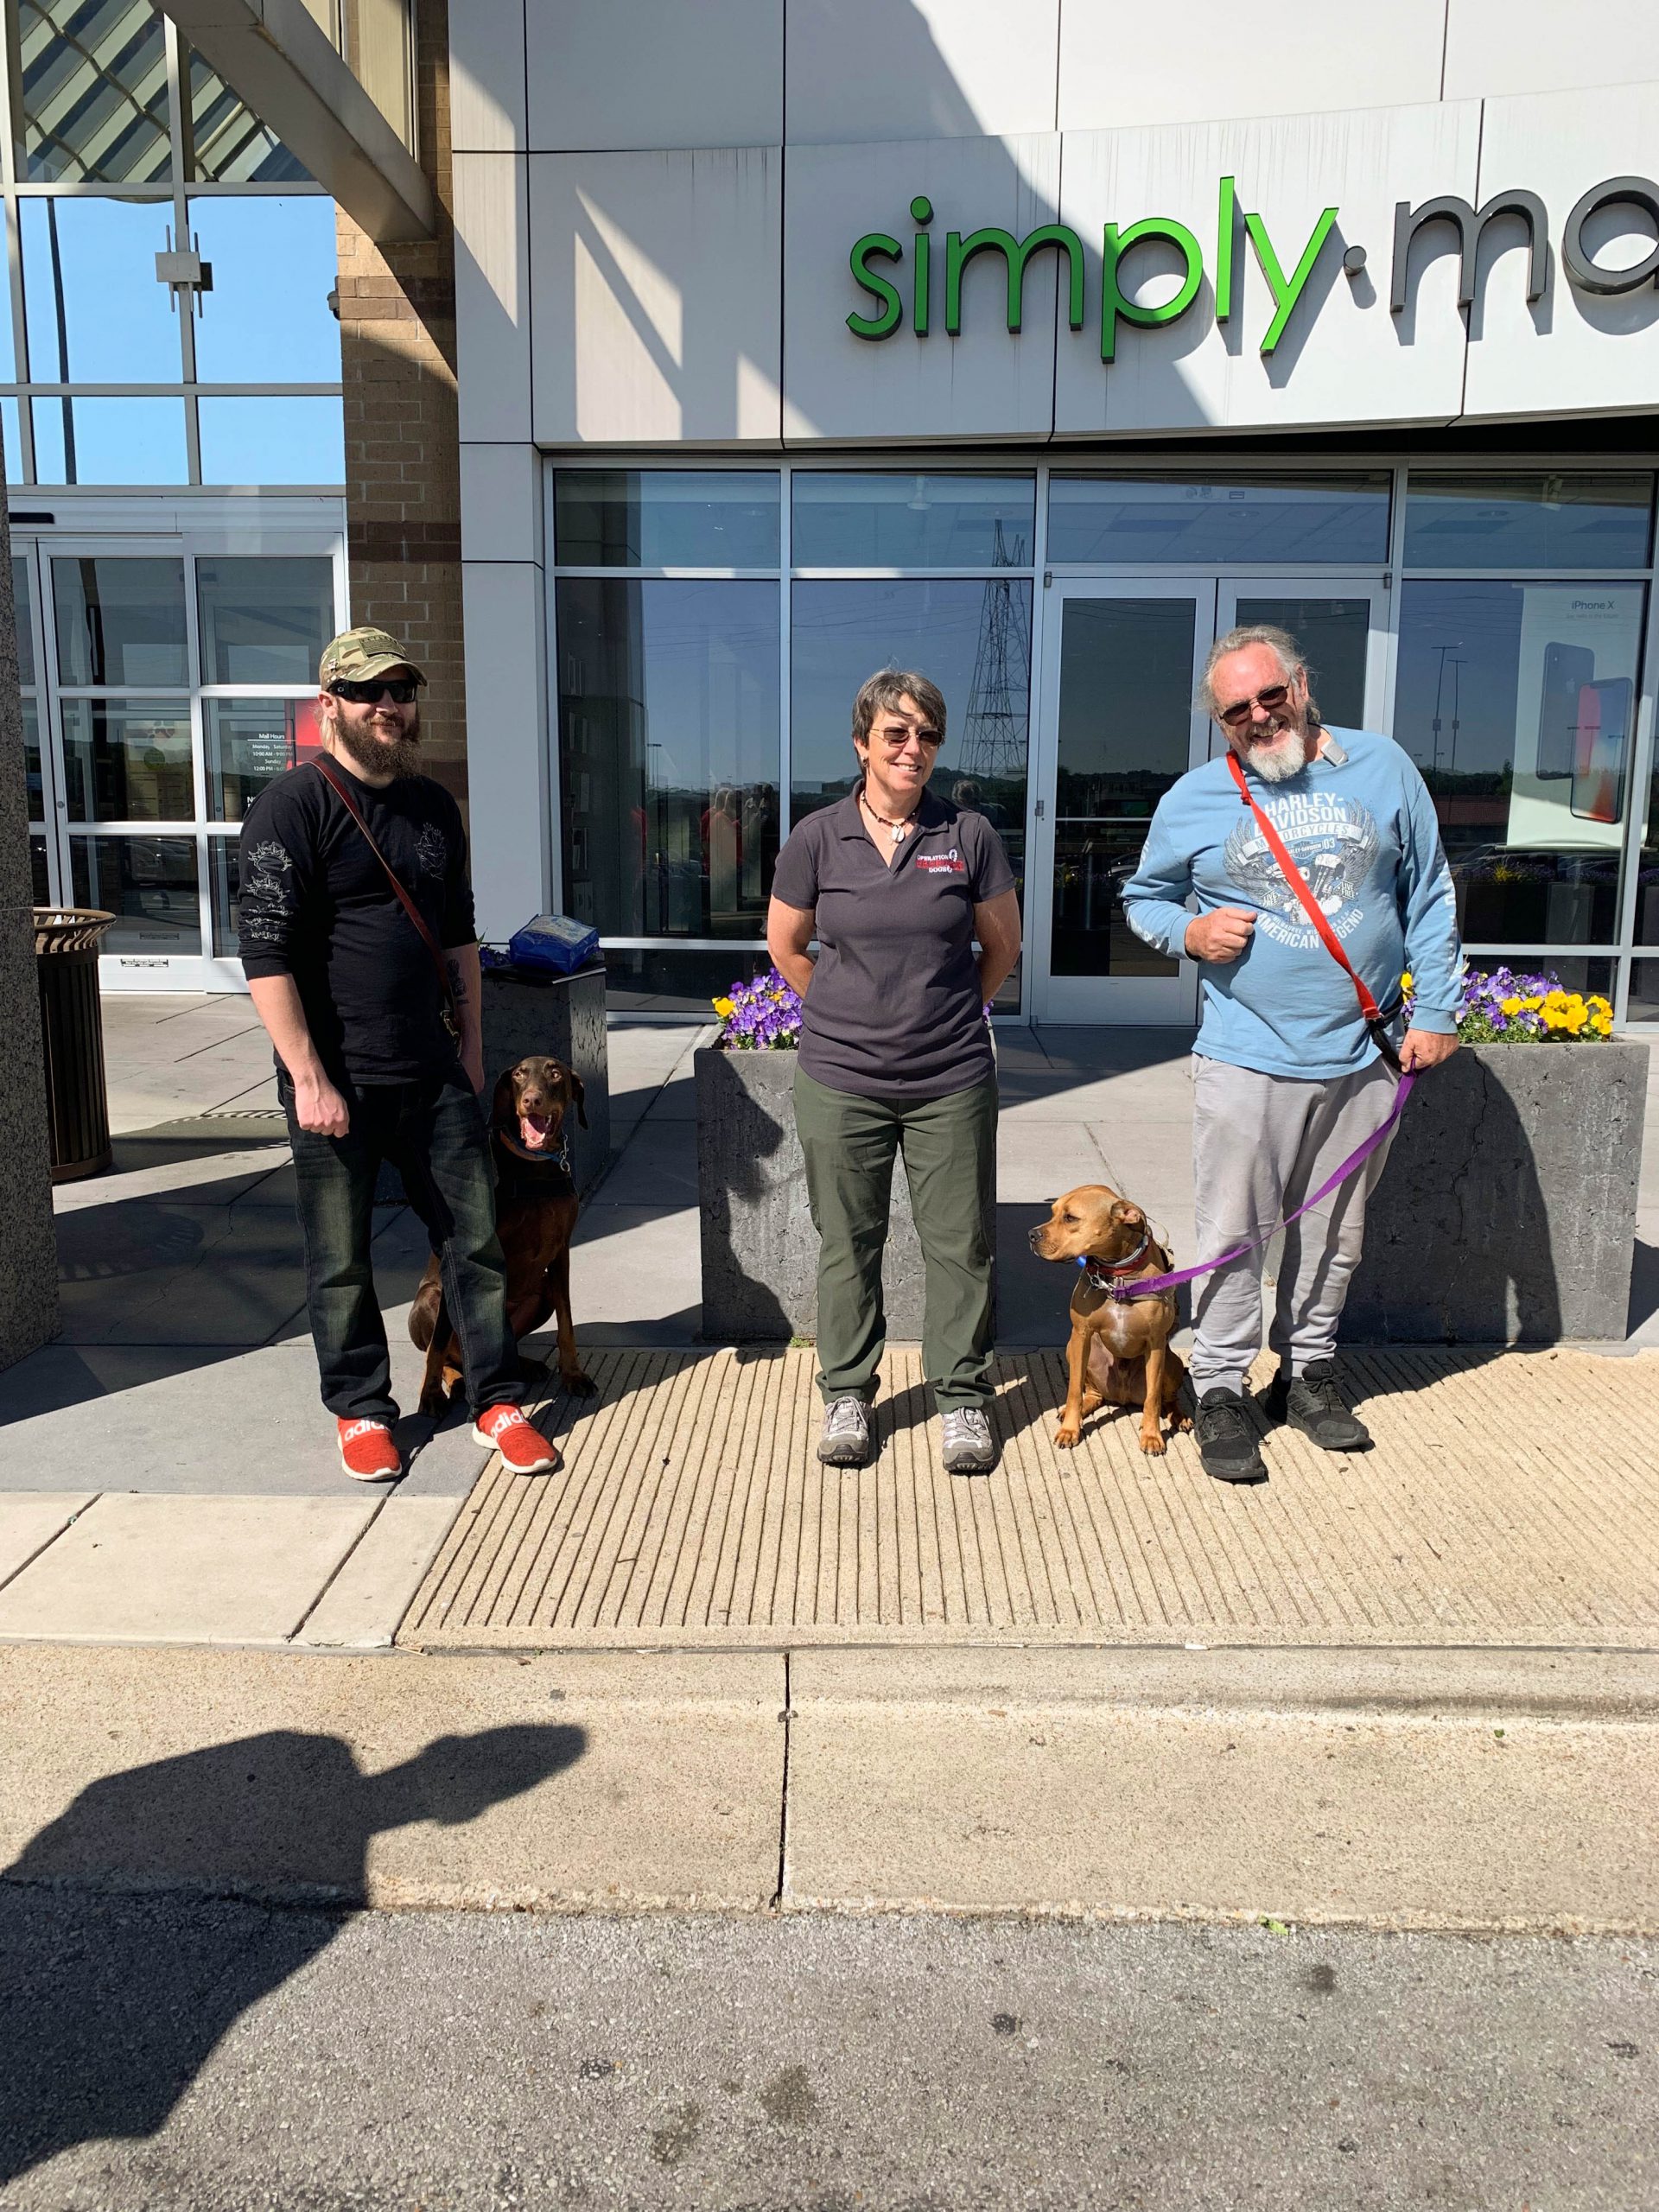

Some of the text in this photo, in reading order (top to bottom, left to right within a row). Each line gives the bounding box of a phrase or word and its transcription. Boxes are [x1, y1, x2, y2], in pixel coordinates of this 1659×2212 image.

[845, 175, 1338, 365] simply
[1572, 601, 1615, 610] iPhone X
[1264, 792, 1344, 817] HARLEY-
[1255, 823, 1350, 850] MORCYCLES
[1256, 908, 1364, 949] AMERICAN GEND
